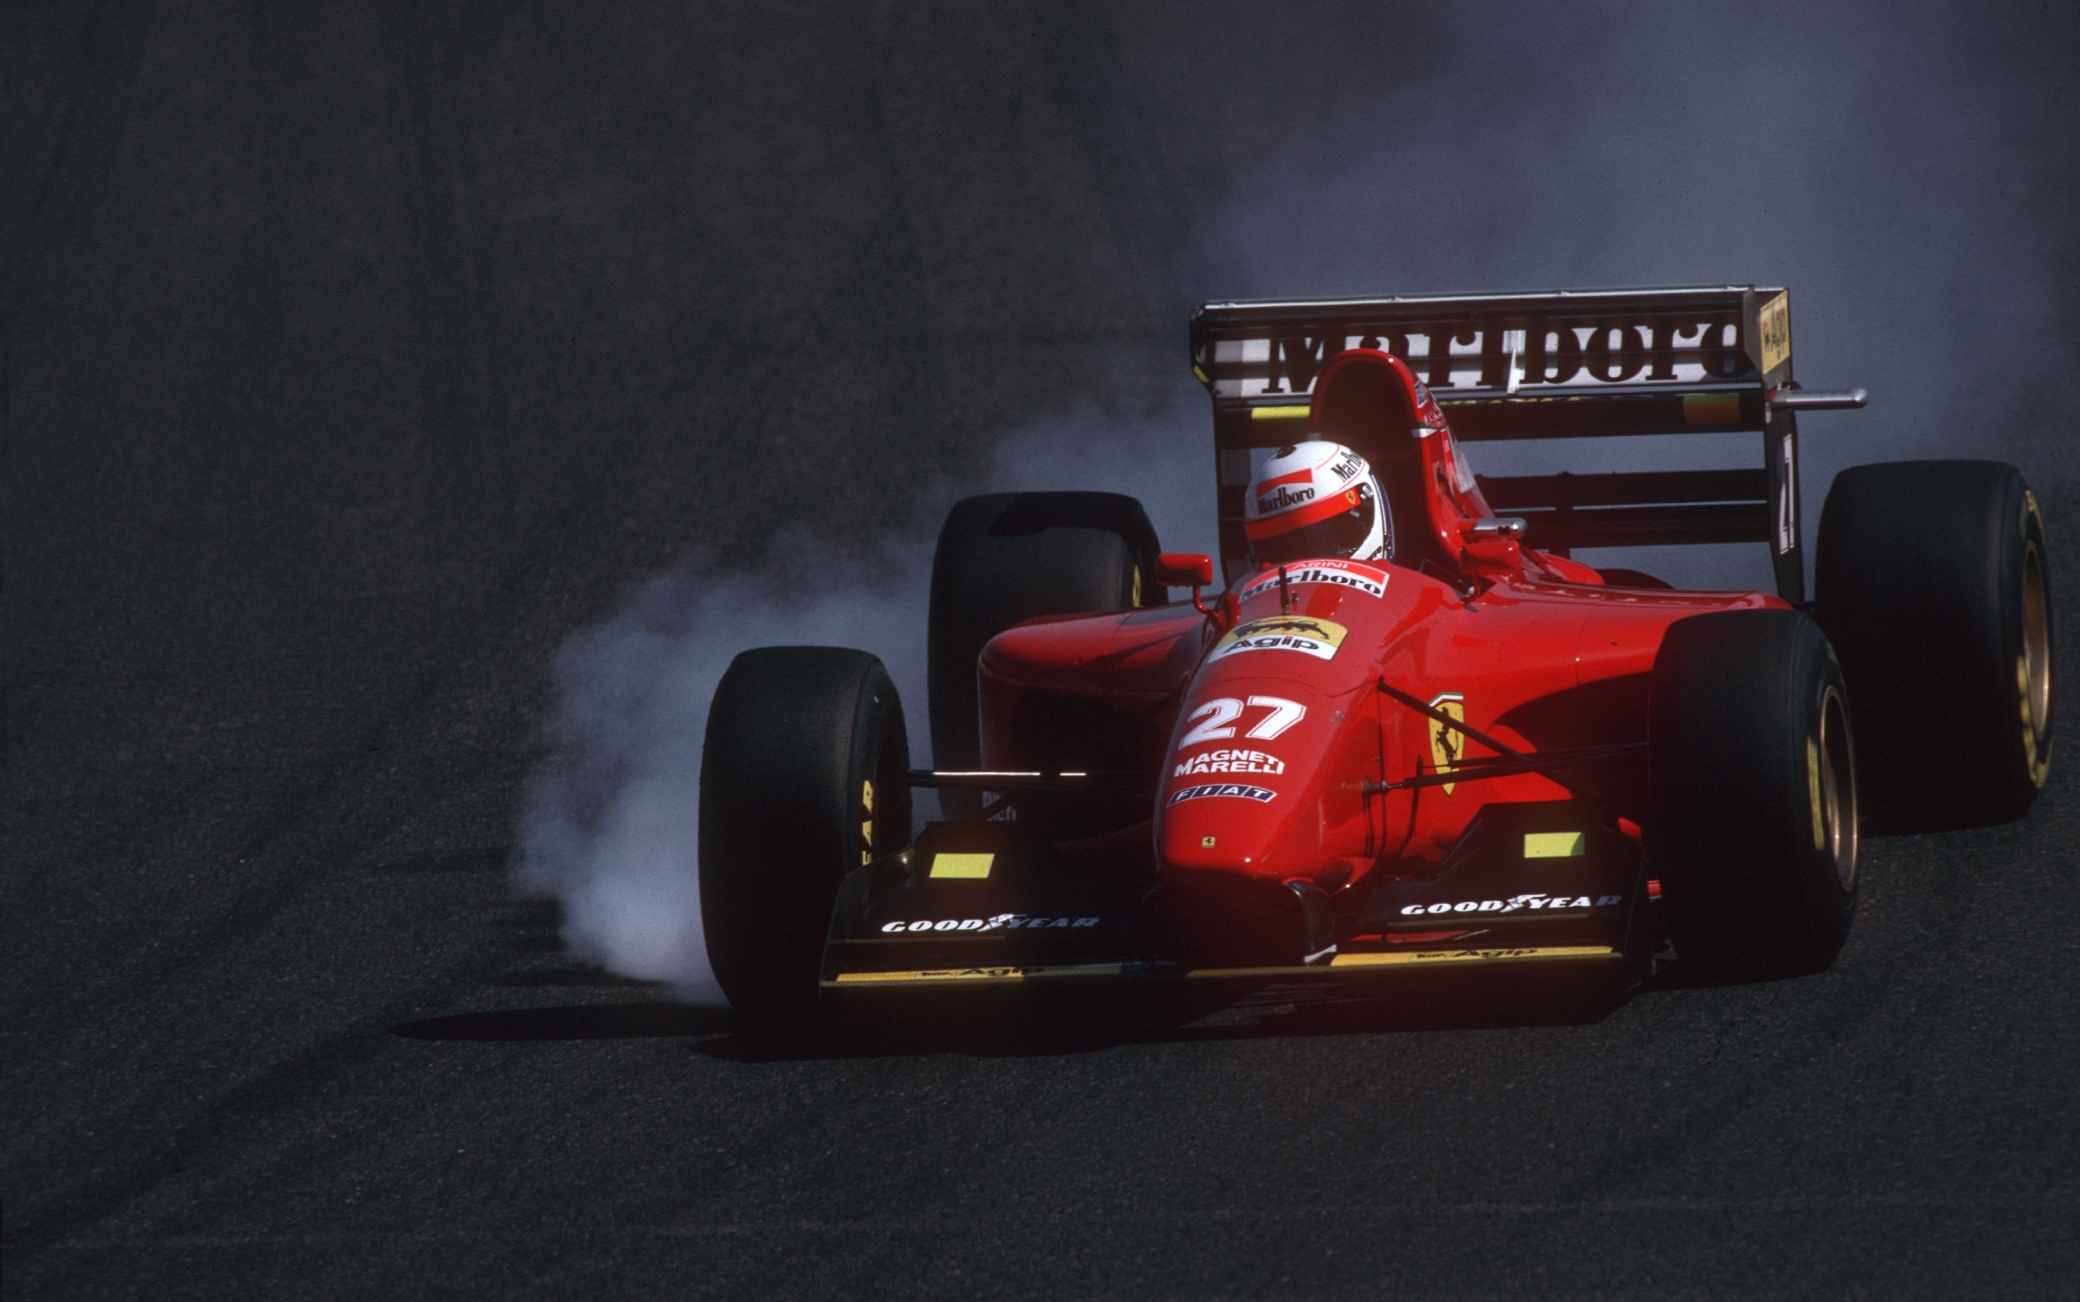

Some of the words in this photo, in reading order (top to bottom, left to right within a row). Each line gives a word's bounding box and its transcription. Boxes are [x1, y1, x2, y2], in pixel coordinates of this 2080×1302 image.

[1257, 487, 1315, 515] Marlboro
[1222, 635, 1320, 655] Agip
[1178, 695, 1307, 750] 27
[1174, 785, 1269, 801] FIAT
